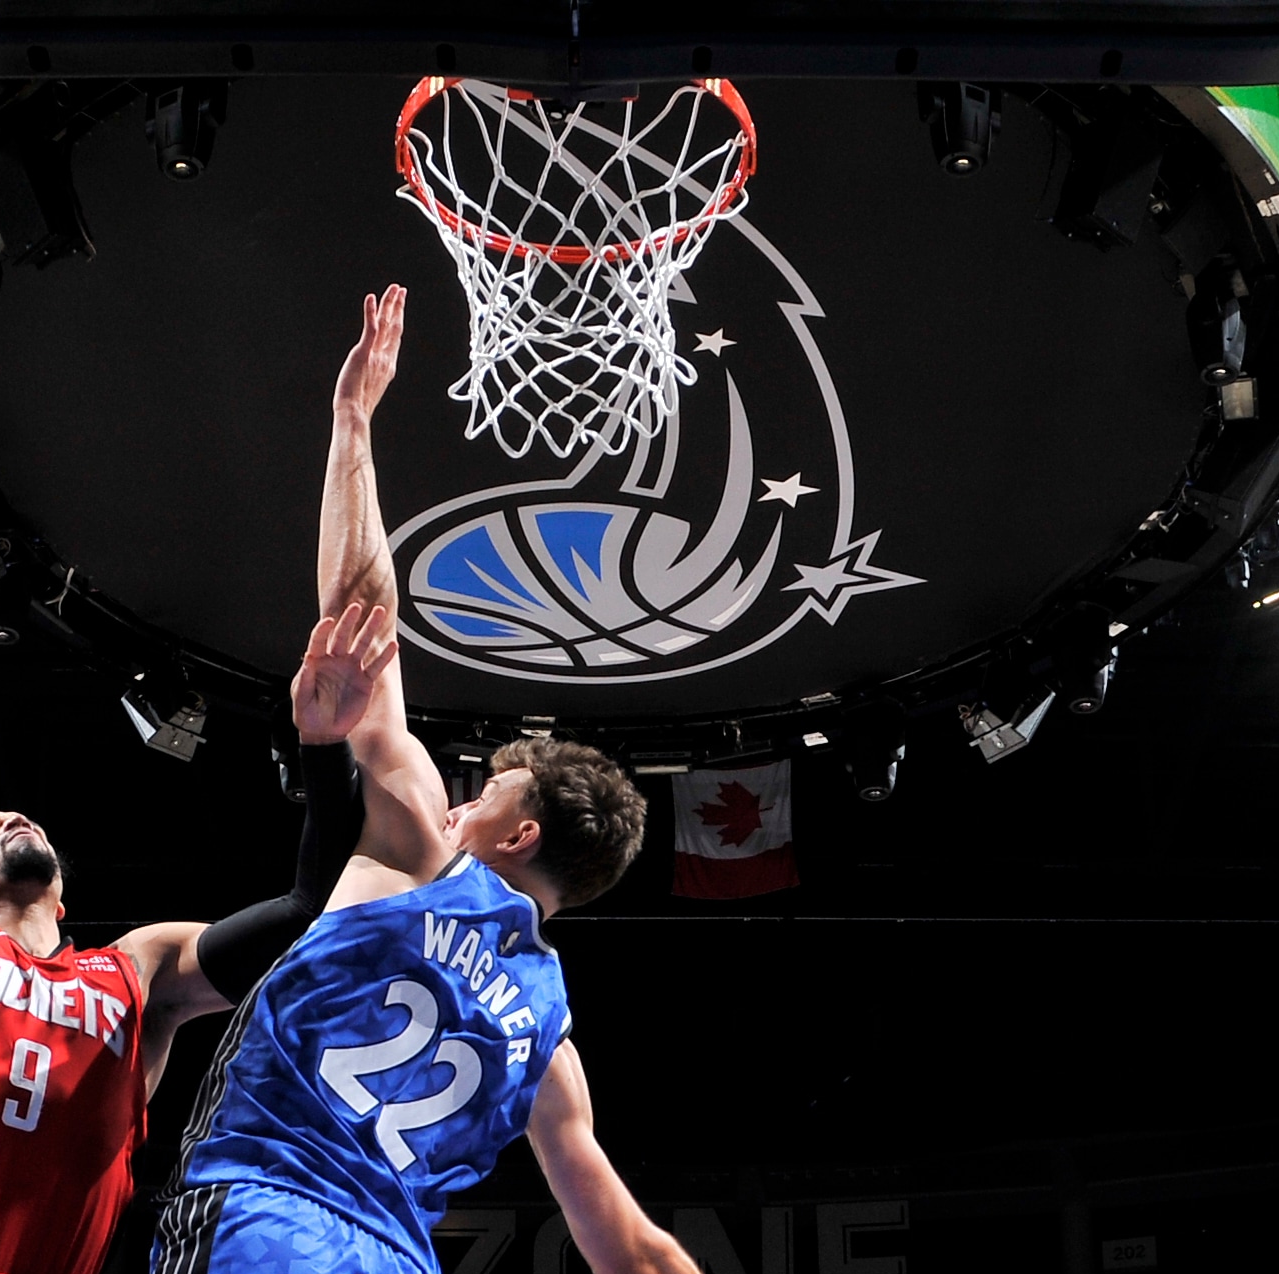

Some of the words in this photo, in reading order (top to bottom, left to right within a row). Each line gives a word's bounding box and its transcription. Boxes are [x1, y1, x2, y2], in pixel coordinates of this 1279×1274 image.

[423, 911, 536, 1067] WAGNER
[1, 1038, 52, 1132] 9
[318, 979, 483, 1173] 22
